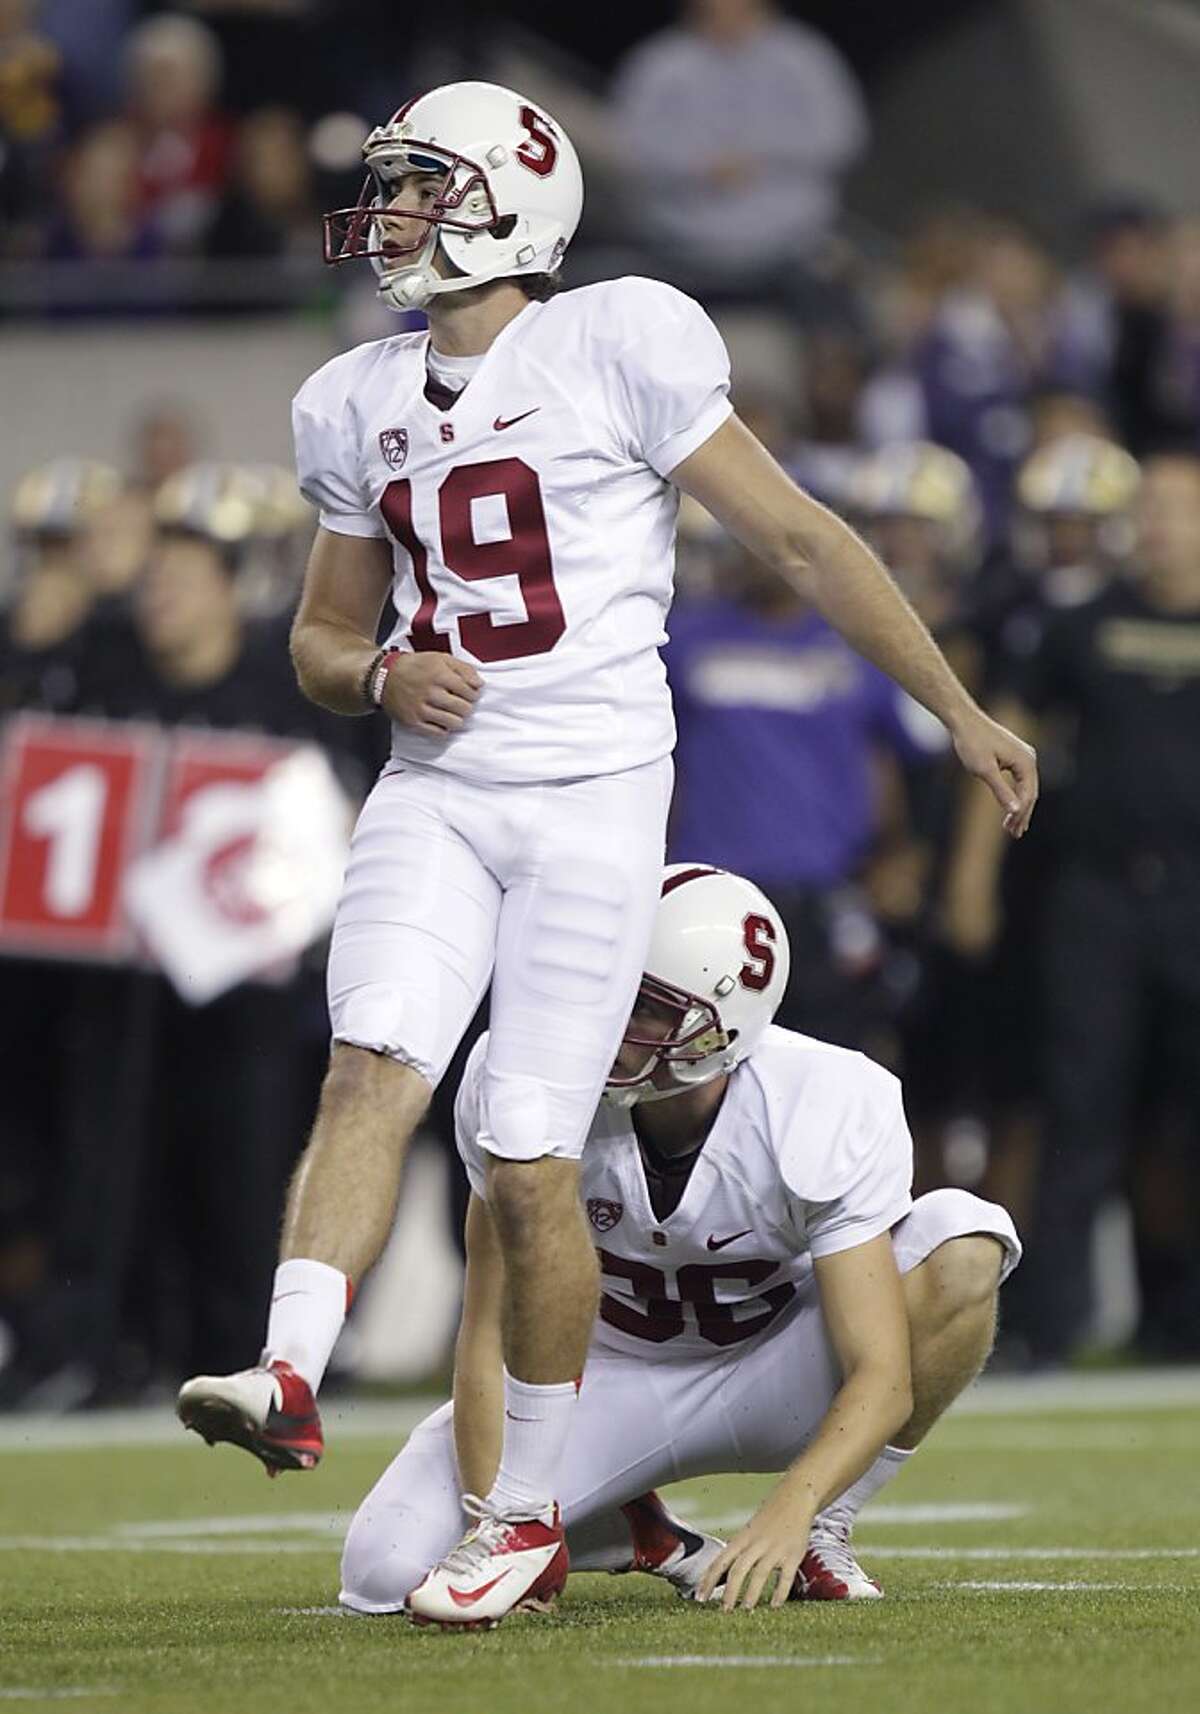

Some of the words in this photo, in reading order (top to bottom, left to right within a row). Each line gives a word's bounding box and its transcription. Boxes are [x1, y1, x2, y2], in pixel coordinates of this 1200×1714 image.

[514, 104, 561, 179] S
[440, 423, 454, 442] S
[379, 456, 567, 663] 19
[23, 761, 109, 920] 1
[739, 912, 777, 992] S
[596, 1246, 796, 1347] 36
